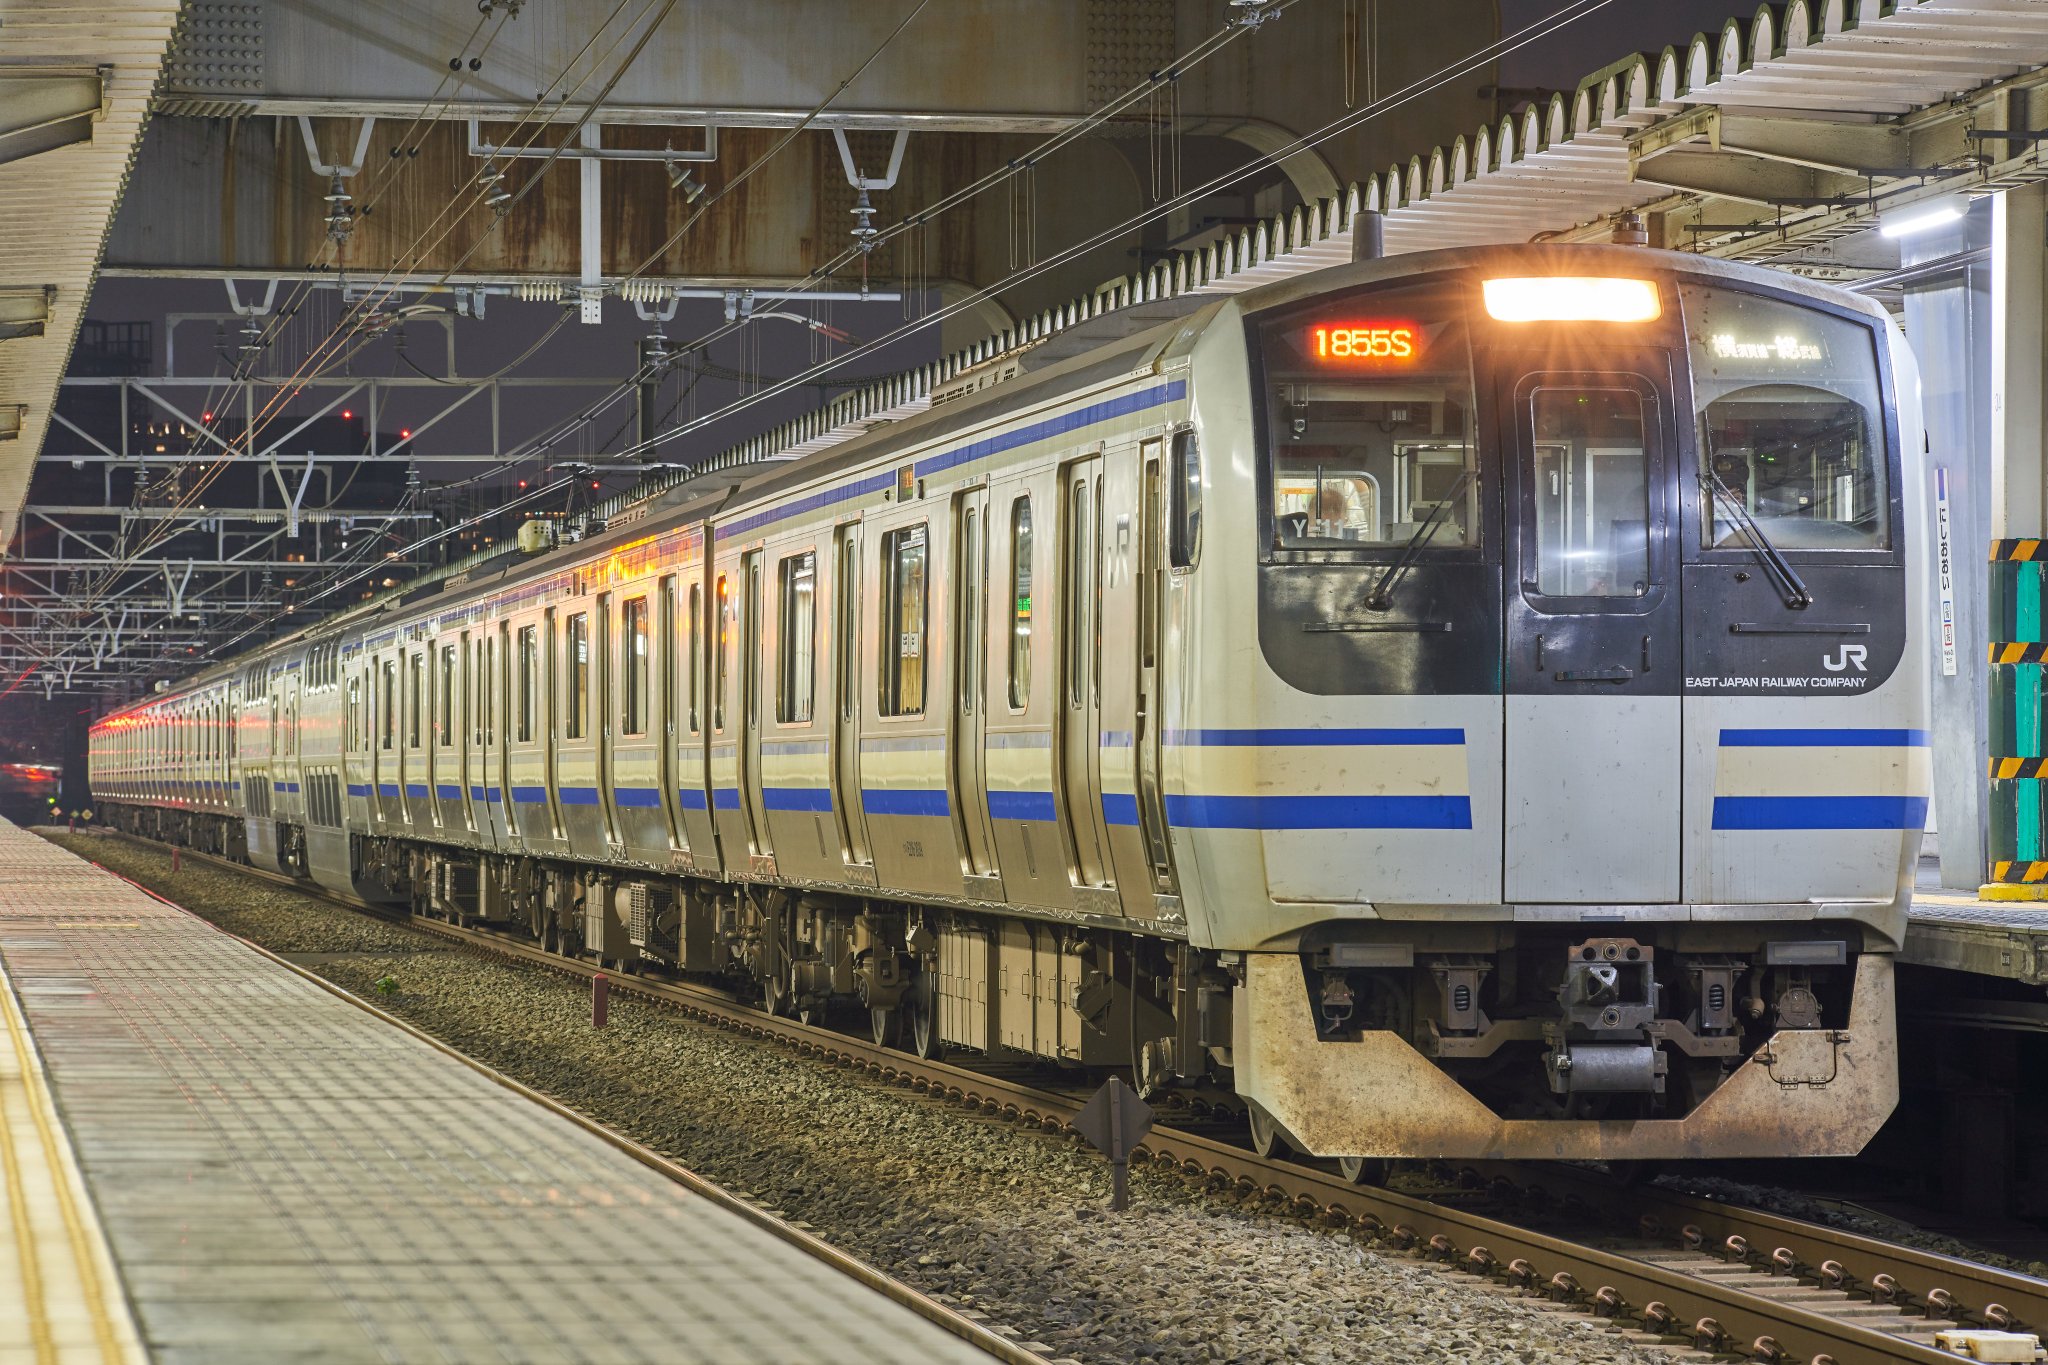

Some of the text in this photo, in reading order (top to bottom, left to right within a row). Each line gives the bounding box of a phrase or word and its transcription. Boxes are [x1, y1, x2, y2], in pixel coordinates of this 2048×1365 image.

[1316, 329, 1411, 357] 1855S
[1292, 519, 1344, 538] Y-11
[1107, 513, 1130, 589] JR
[1939, 507, 1950, 591] にしおおい
[1823, 644, 1868, 671] JR
[1685, 677, 1867, 688] EAST JAPAN RAILWAY COMPANY
